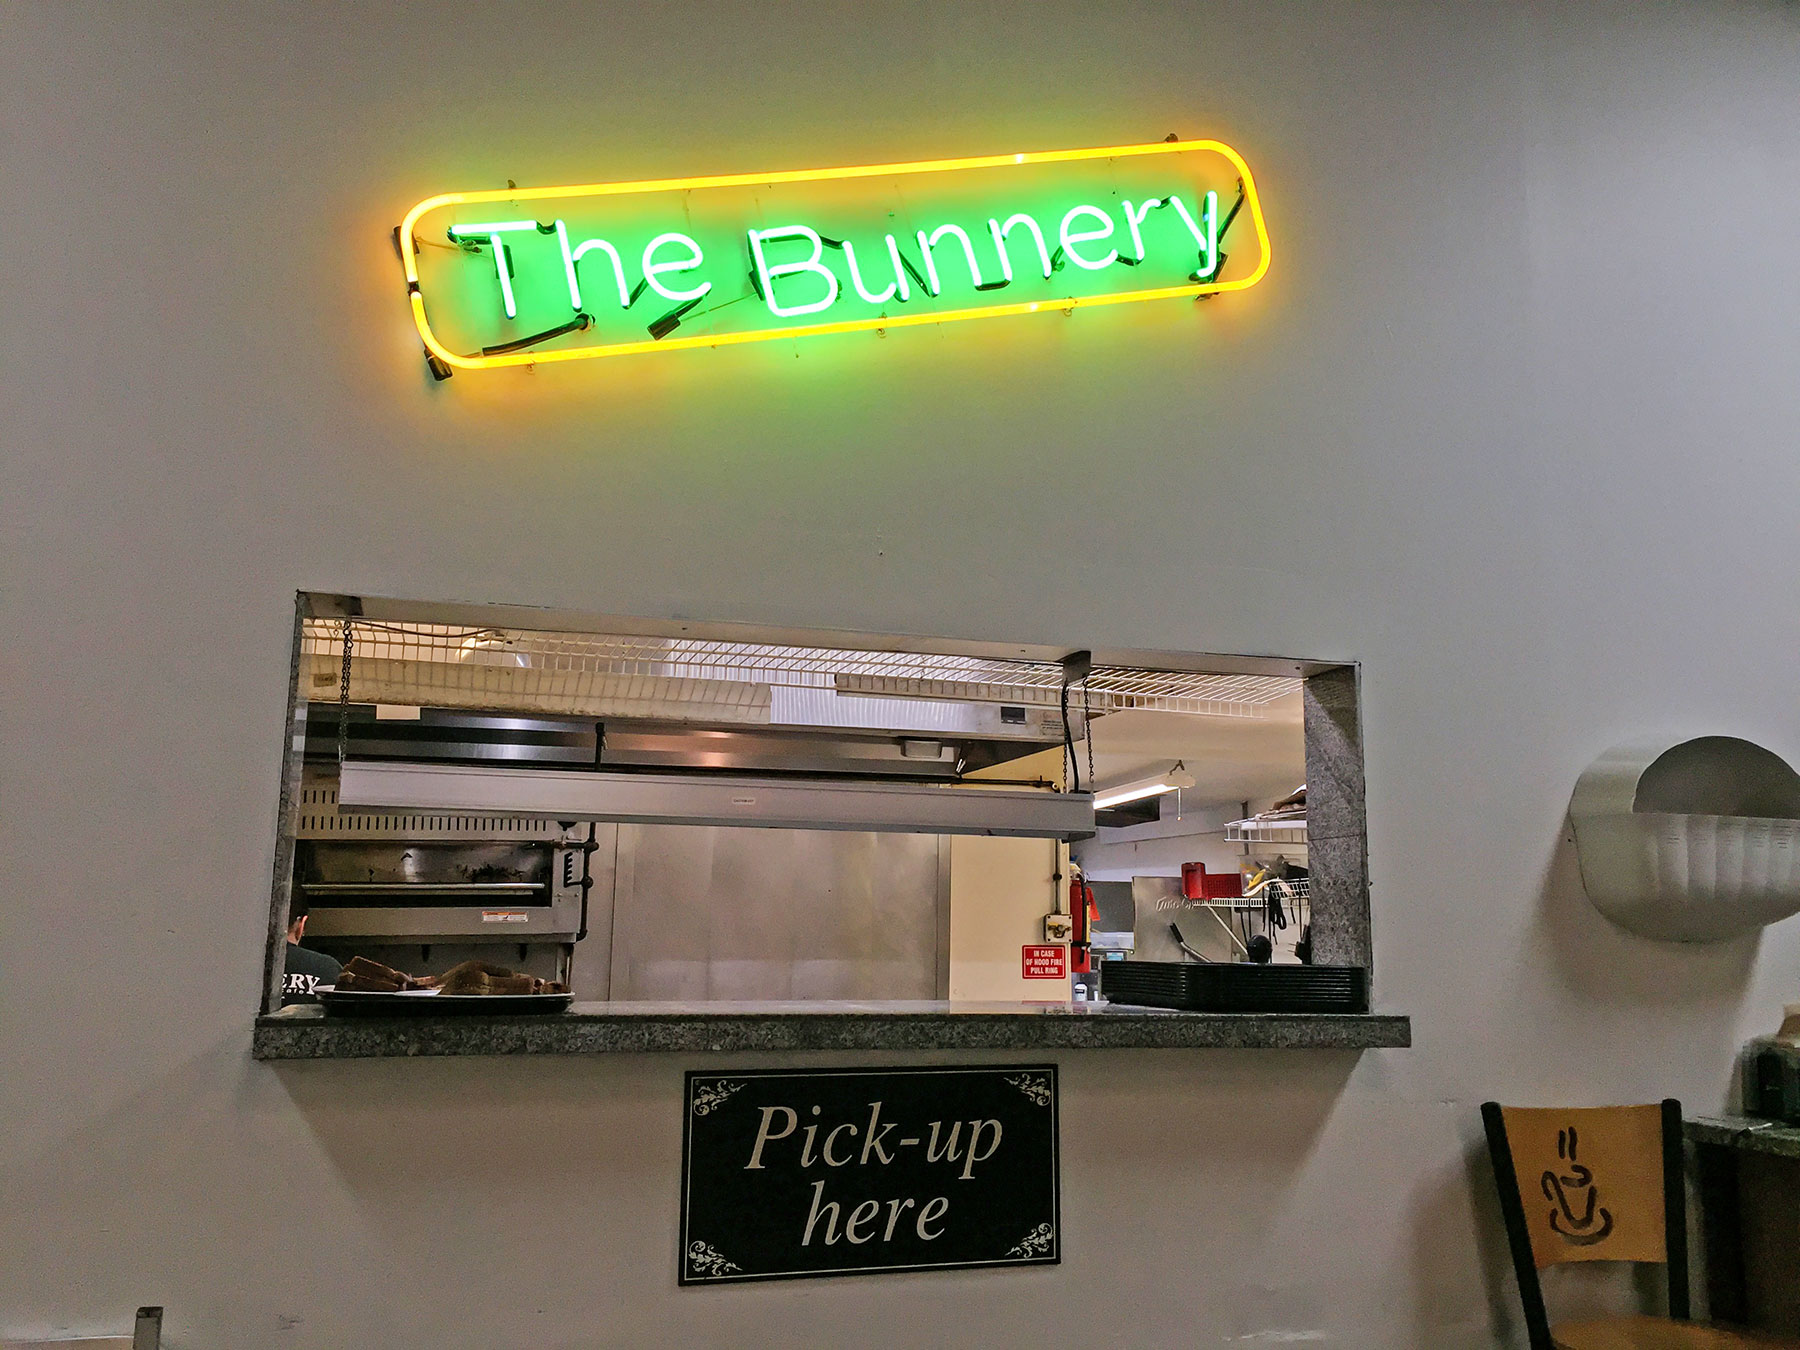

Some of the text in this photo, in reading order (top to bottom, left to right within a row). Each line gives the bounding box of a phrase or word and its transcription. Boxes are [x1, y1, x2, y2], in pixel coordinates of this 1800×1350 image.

[450, 190, 1219, 319] The Bunnery
[1026, 958, 1063, 966] OF HOOD FIRE
[743, 1101, 1003, 1180] Pick-up
[801, 1179, 949, 1246] here
